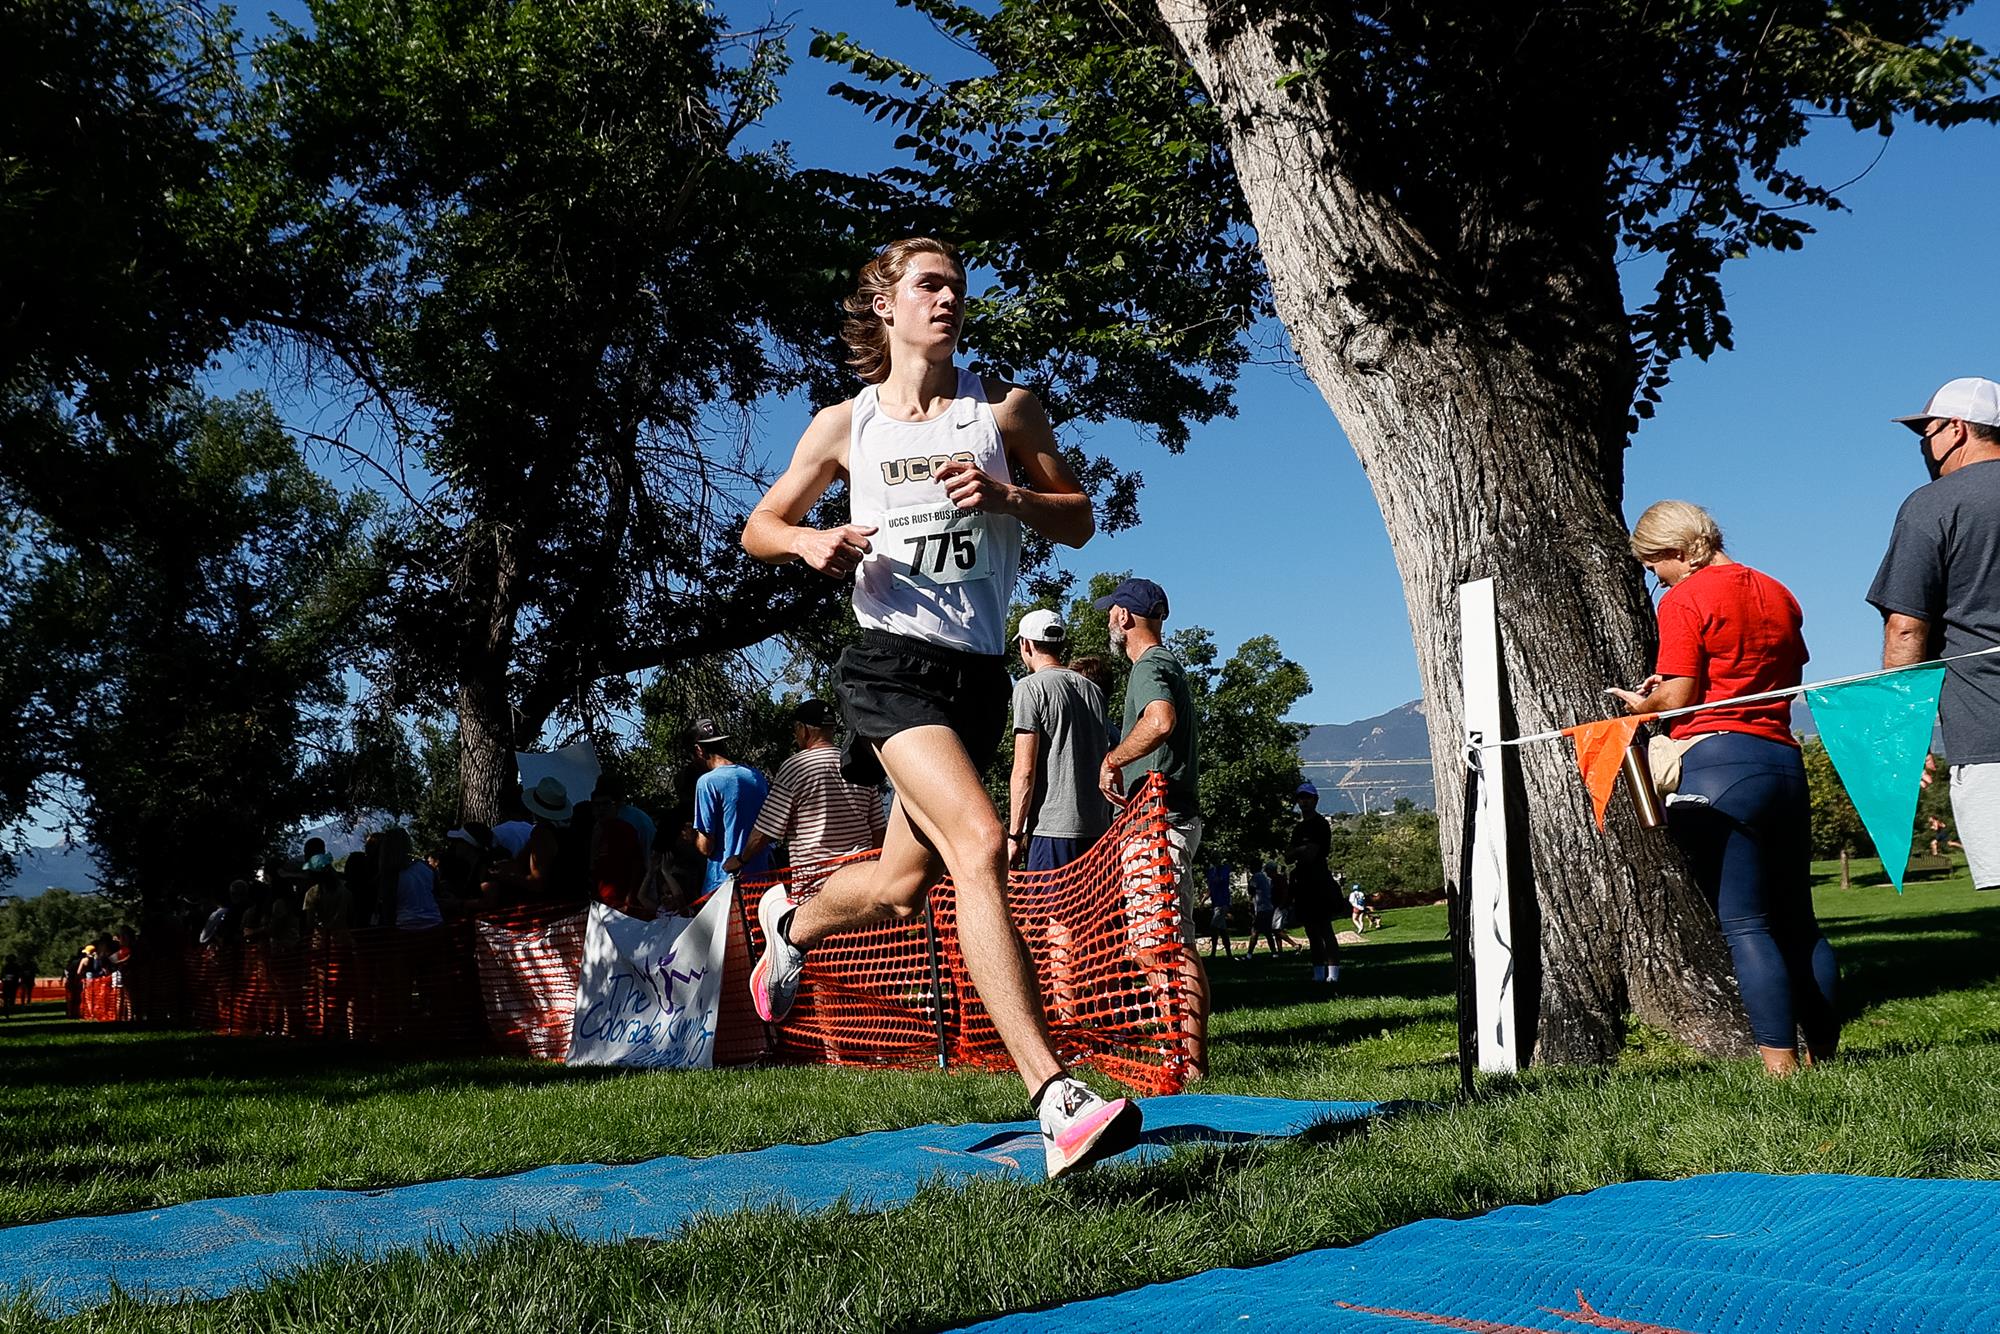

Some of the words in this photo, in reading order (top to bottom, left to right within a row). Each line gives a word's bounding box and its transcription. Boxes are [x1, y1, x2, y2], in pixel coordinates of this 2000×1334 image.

[888, 516, 910, 528] UCCS
[904, 529, 977, 577] 775
[609, 973, 651, 1014] The
